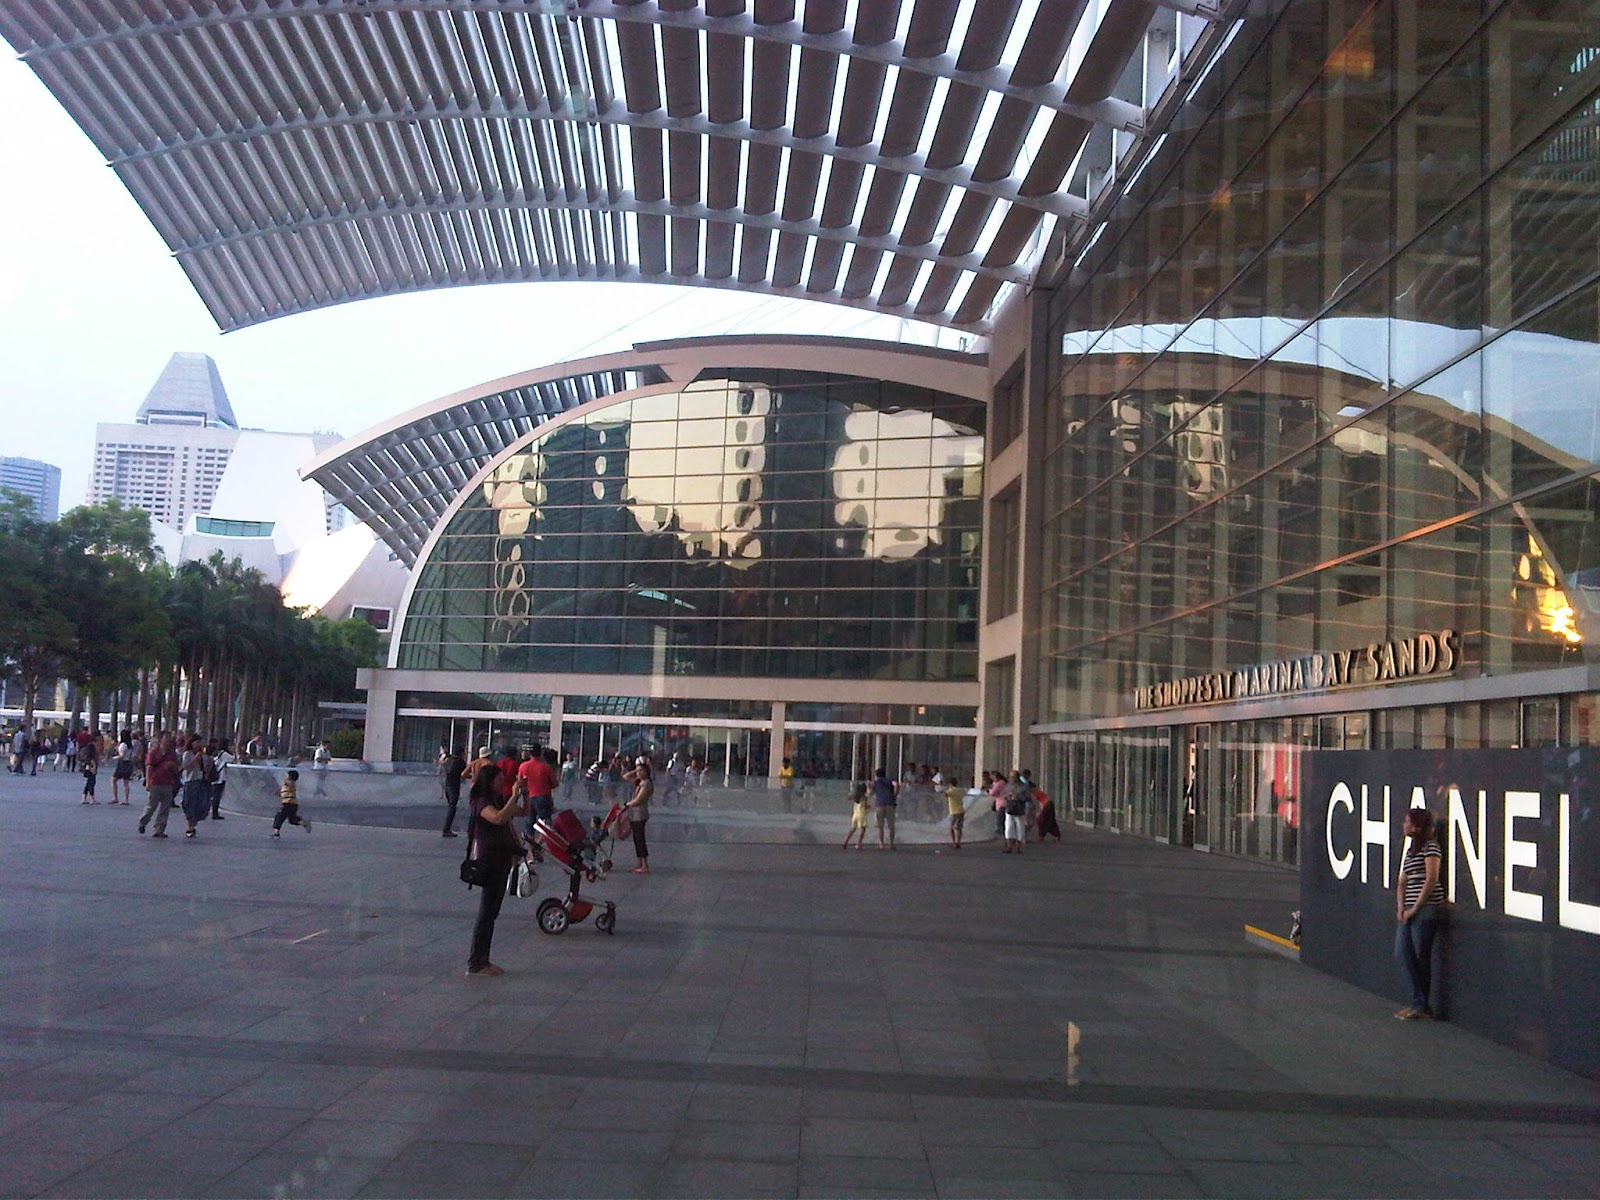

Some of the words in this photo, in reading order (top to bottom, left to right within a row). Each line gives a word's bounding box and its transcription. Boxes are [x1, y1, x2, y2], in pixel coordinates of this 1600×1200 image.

[1134, 684, 1155, 709] THE
[1155, 673, 1213, 707] SHOPPES
[1213, 670, 1234, 700] AT
[1236, 659, 1304, 697] MARINA
[1309, 650, 1350, 688] BAY
[1367, 629, 1455, 681] SANDS
